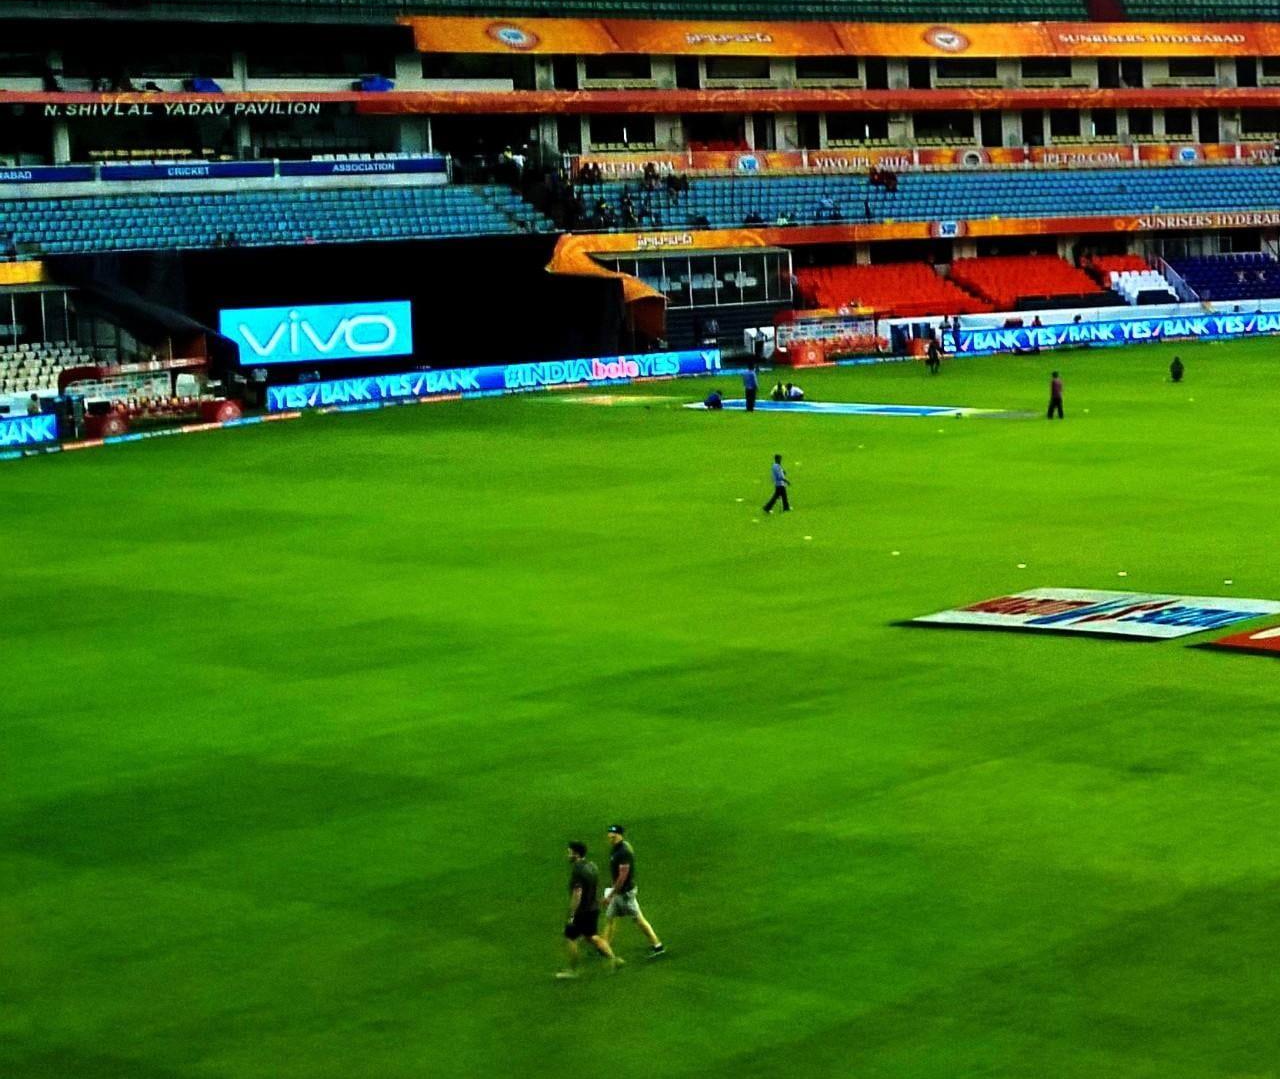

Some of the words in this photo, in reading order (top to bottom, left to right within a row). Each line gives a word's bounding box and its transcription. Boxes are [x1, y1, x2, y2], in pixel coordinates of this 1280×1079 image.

[65, 102, 153, 116] SHIVLAL
[164, 102, 225, 115] YADAV
[234, 102, 321, 116] PAVILION
[167, 166, 210, 177] CRICKET
[332, 162, 396, 174] ASSOCIATION
[815, 157, 848, 168] VIVO
[1138, 215, 1213, 229] SUNRISERS
[973, 328, 1021, 351] BANK
[1024, 326, 1057, 347] YES
[1120, 320, 1151, 339] YES
[1163, 318, 1210, 336] BANK
[1213, 316, 1245, 334] YES
[271, 385, 308, 408] YES
[320, 377, 371, 404] BANK
[375, 374, 416, 397] YES
[426, 369, 481, 393] BANK
